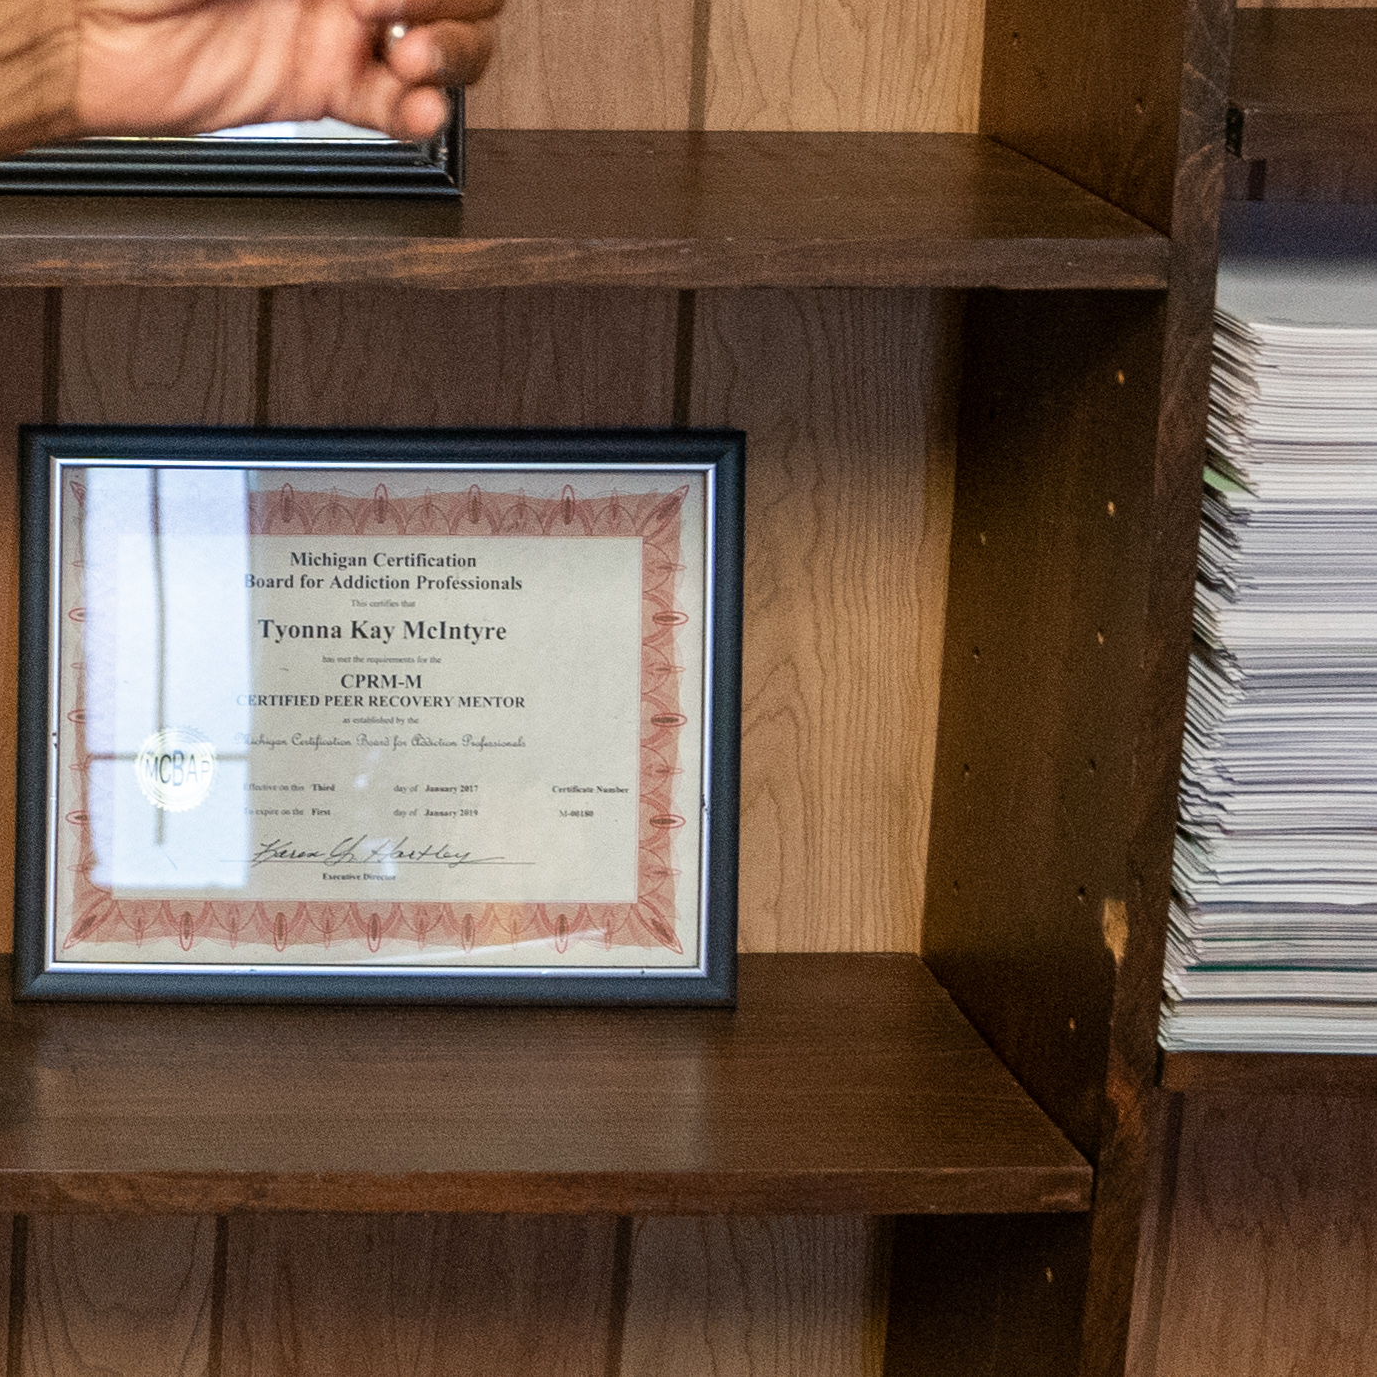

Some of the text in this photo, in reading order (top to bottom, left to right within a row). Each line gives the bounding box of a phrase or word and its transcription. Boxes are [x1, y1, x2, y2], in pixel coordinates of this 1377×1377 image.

[290, 551, 477, 570] Michigan Certification
[244, 573, 522, 591] Board for Addiction Professionals
[258, 619, 507, 645] Tyonna Kay McIntyre
[340, 673, 422, 689] CPRM-M
[236, 695, 525, 708] CERTIFIED PEER RECOVERY MENTOR
